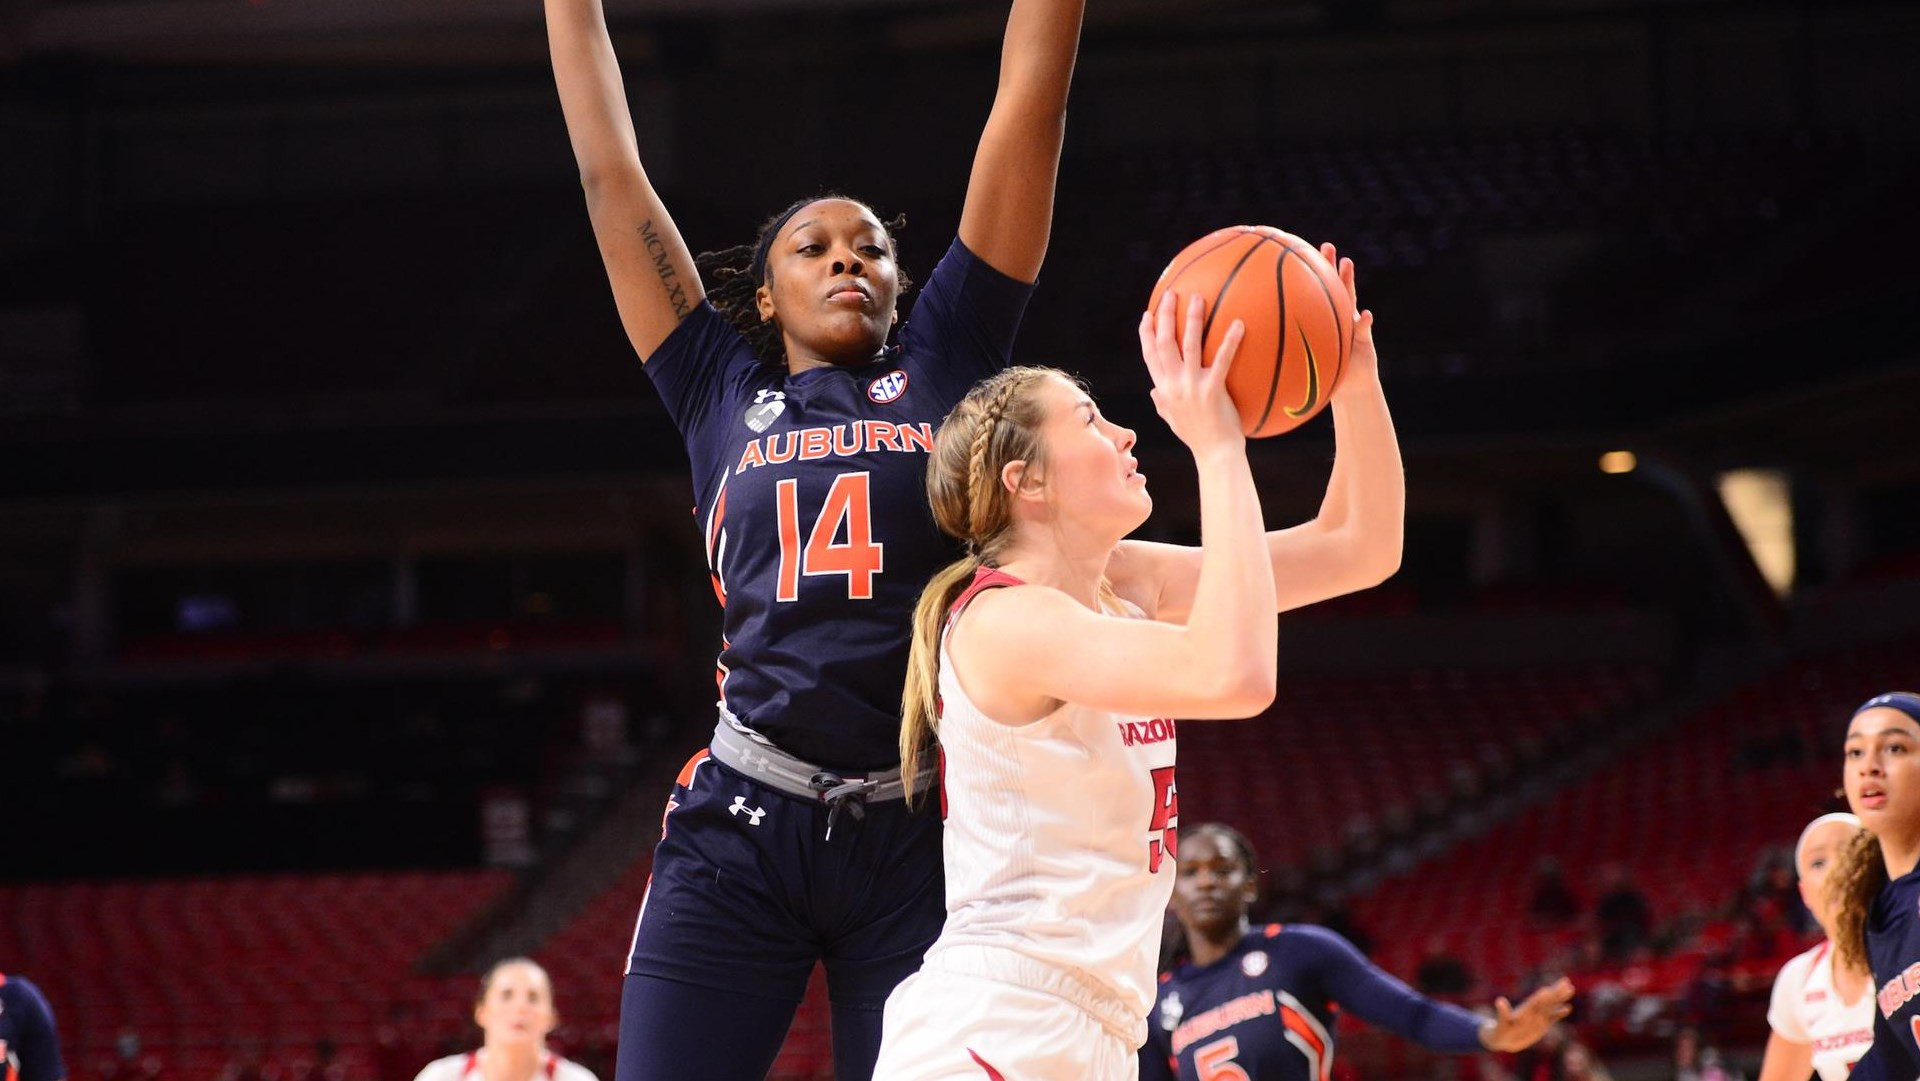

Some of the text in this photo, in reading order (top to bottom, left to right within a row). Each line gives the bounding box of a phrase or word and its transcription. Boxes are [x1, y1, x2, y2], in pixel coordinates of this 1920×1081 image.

[869, 372, 906, 401] SEC
[736, 420, 935, 475] AUBURN
[776, 471, 883, 602] 14
[1193, 1035, 1252, 1081] 5
